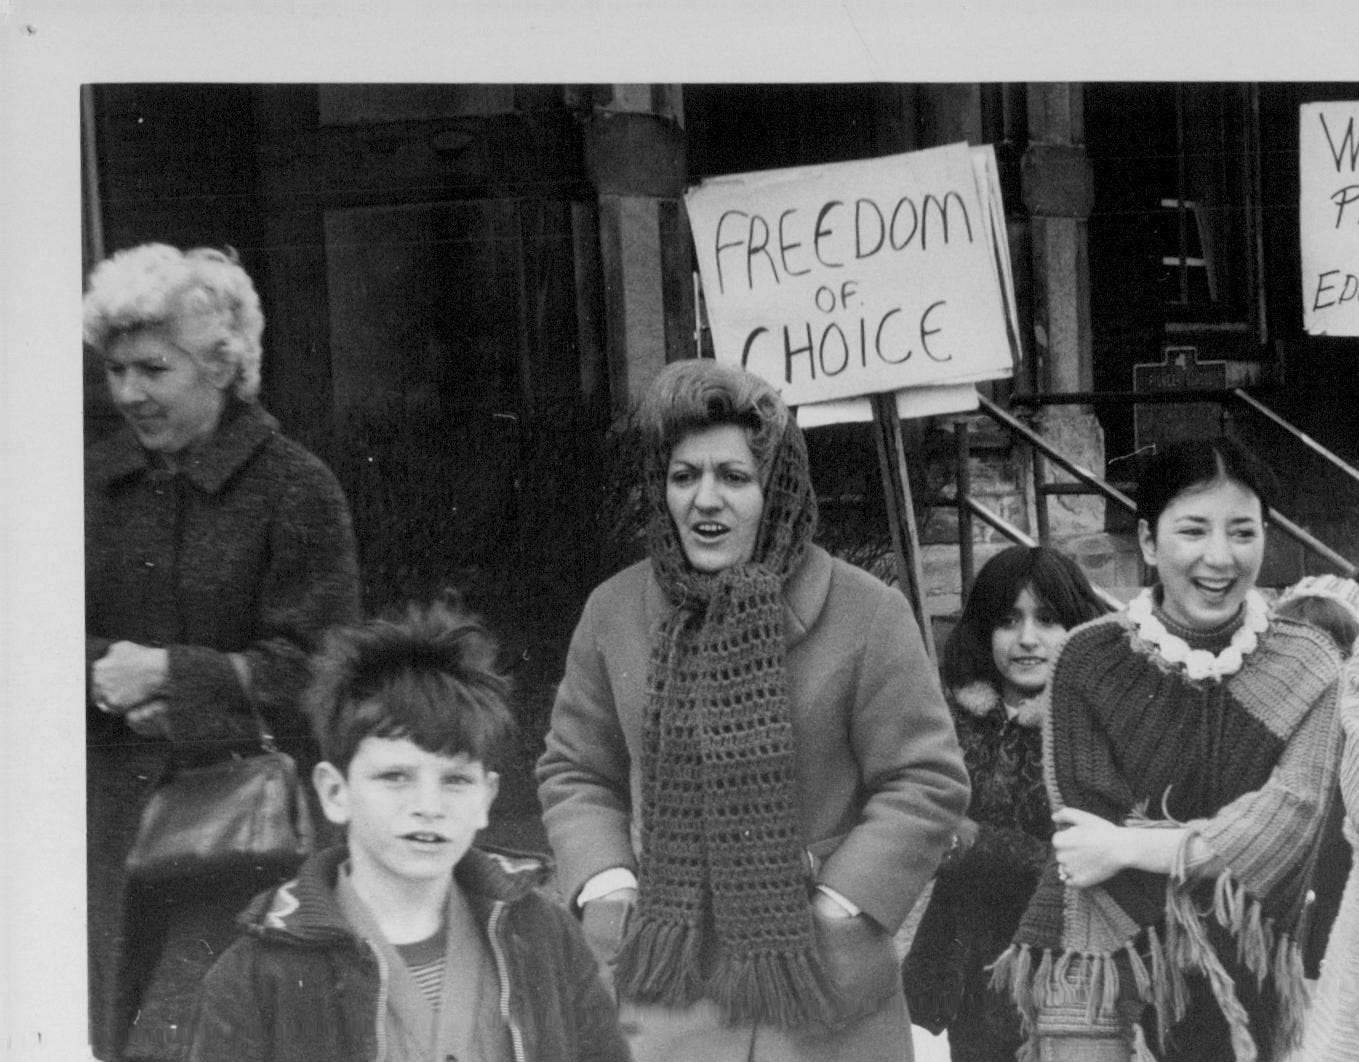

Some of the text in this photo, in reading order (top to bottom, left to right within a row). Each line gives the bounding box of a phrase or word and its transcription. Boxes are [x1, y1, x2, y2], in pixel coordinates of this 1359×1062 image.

[715, 191, 974, 295] FREEDOM
[814, 280, 859, 314] OF
[741, 300, 953, 385] CHOICE
